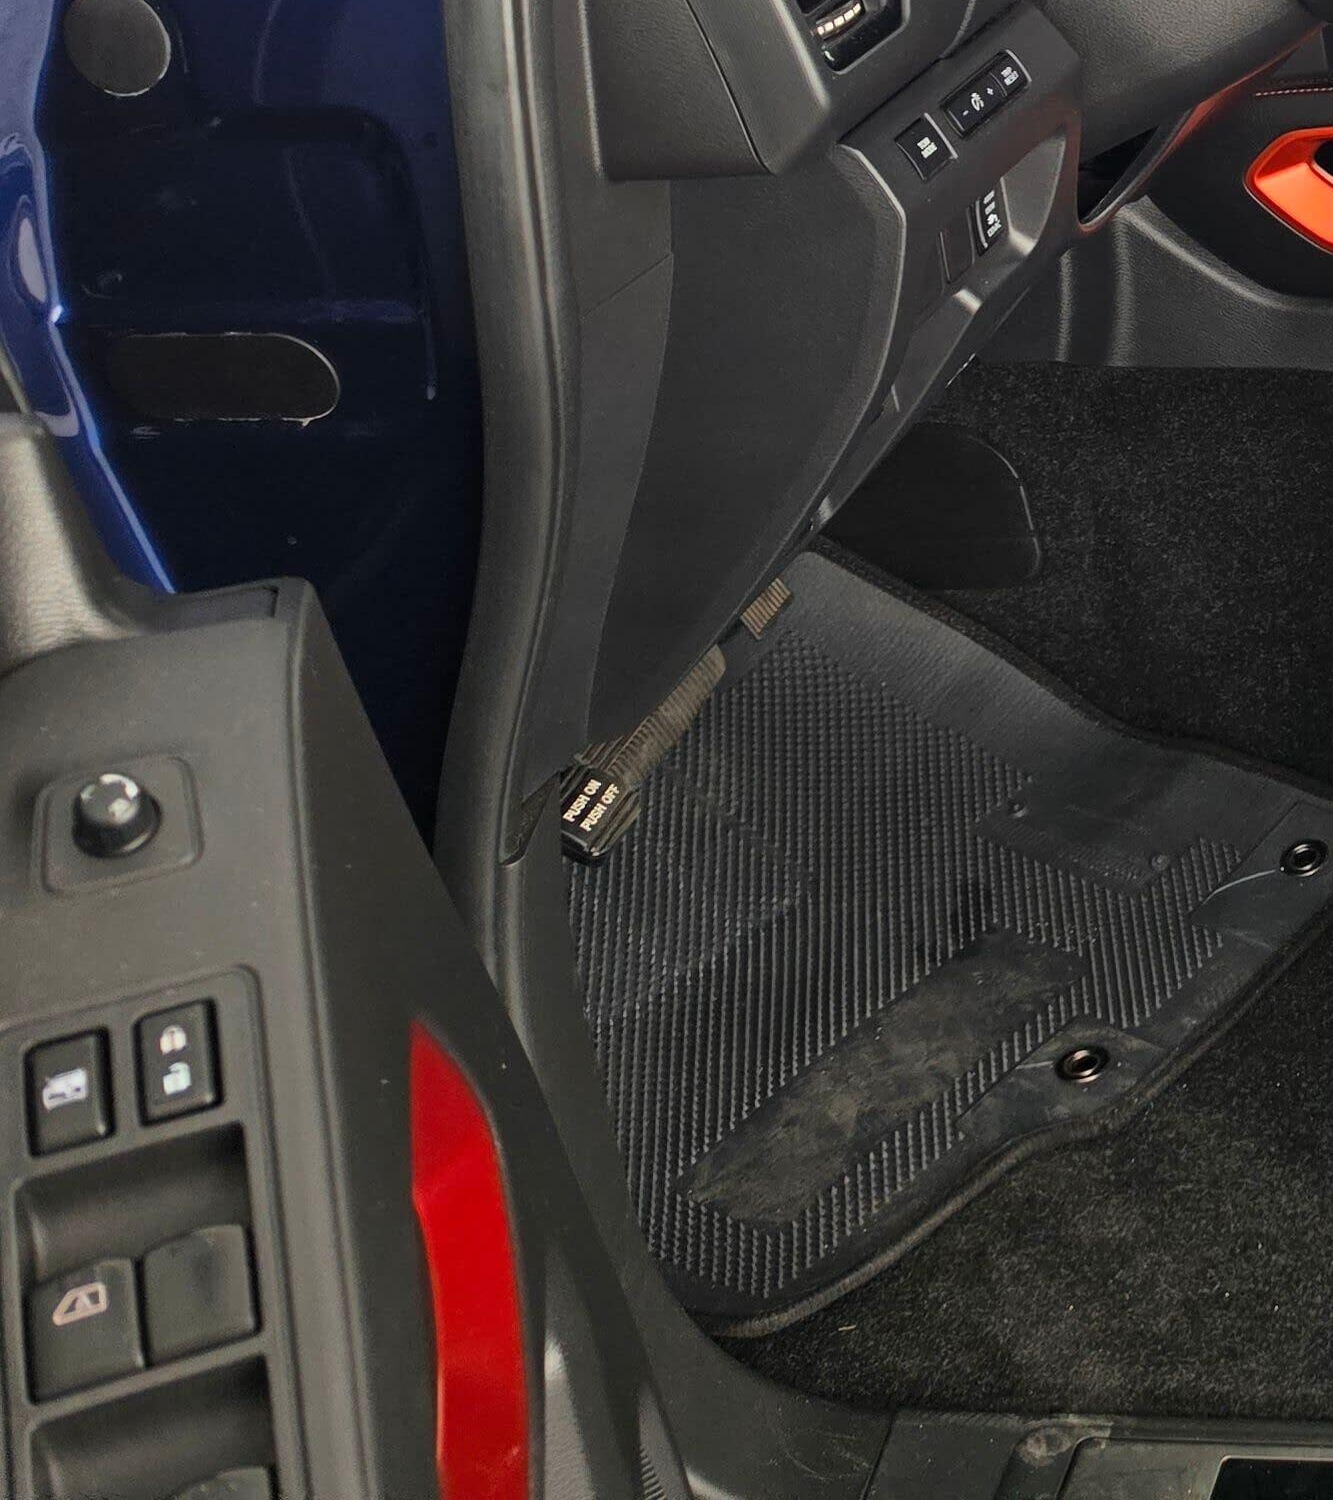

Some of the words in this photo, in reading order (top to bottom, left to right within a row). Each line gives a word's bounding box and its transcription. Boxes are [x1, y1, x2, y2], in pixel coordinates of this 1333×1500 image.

[562, 794, 591, 822] PUSH
[584, 779, 602, 796] ON
[580, 802, 607, 832] PUSH
[601, 783, 619, 805] OFF
